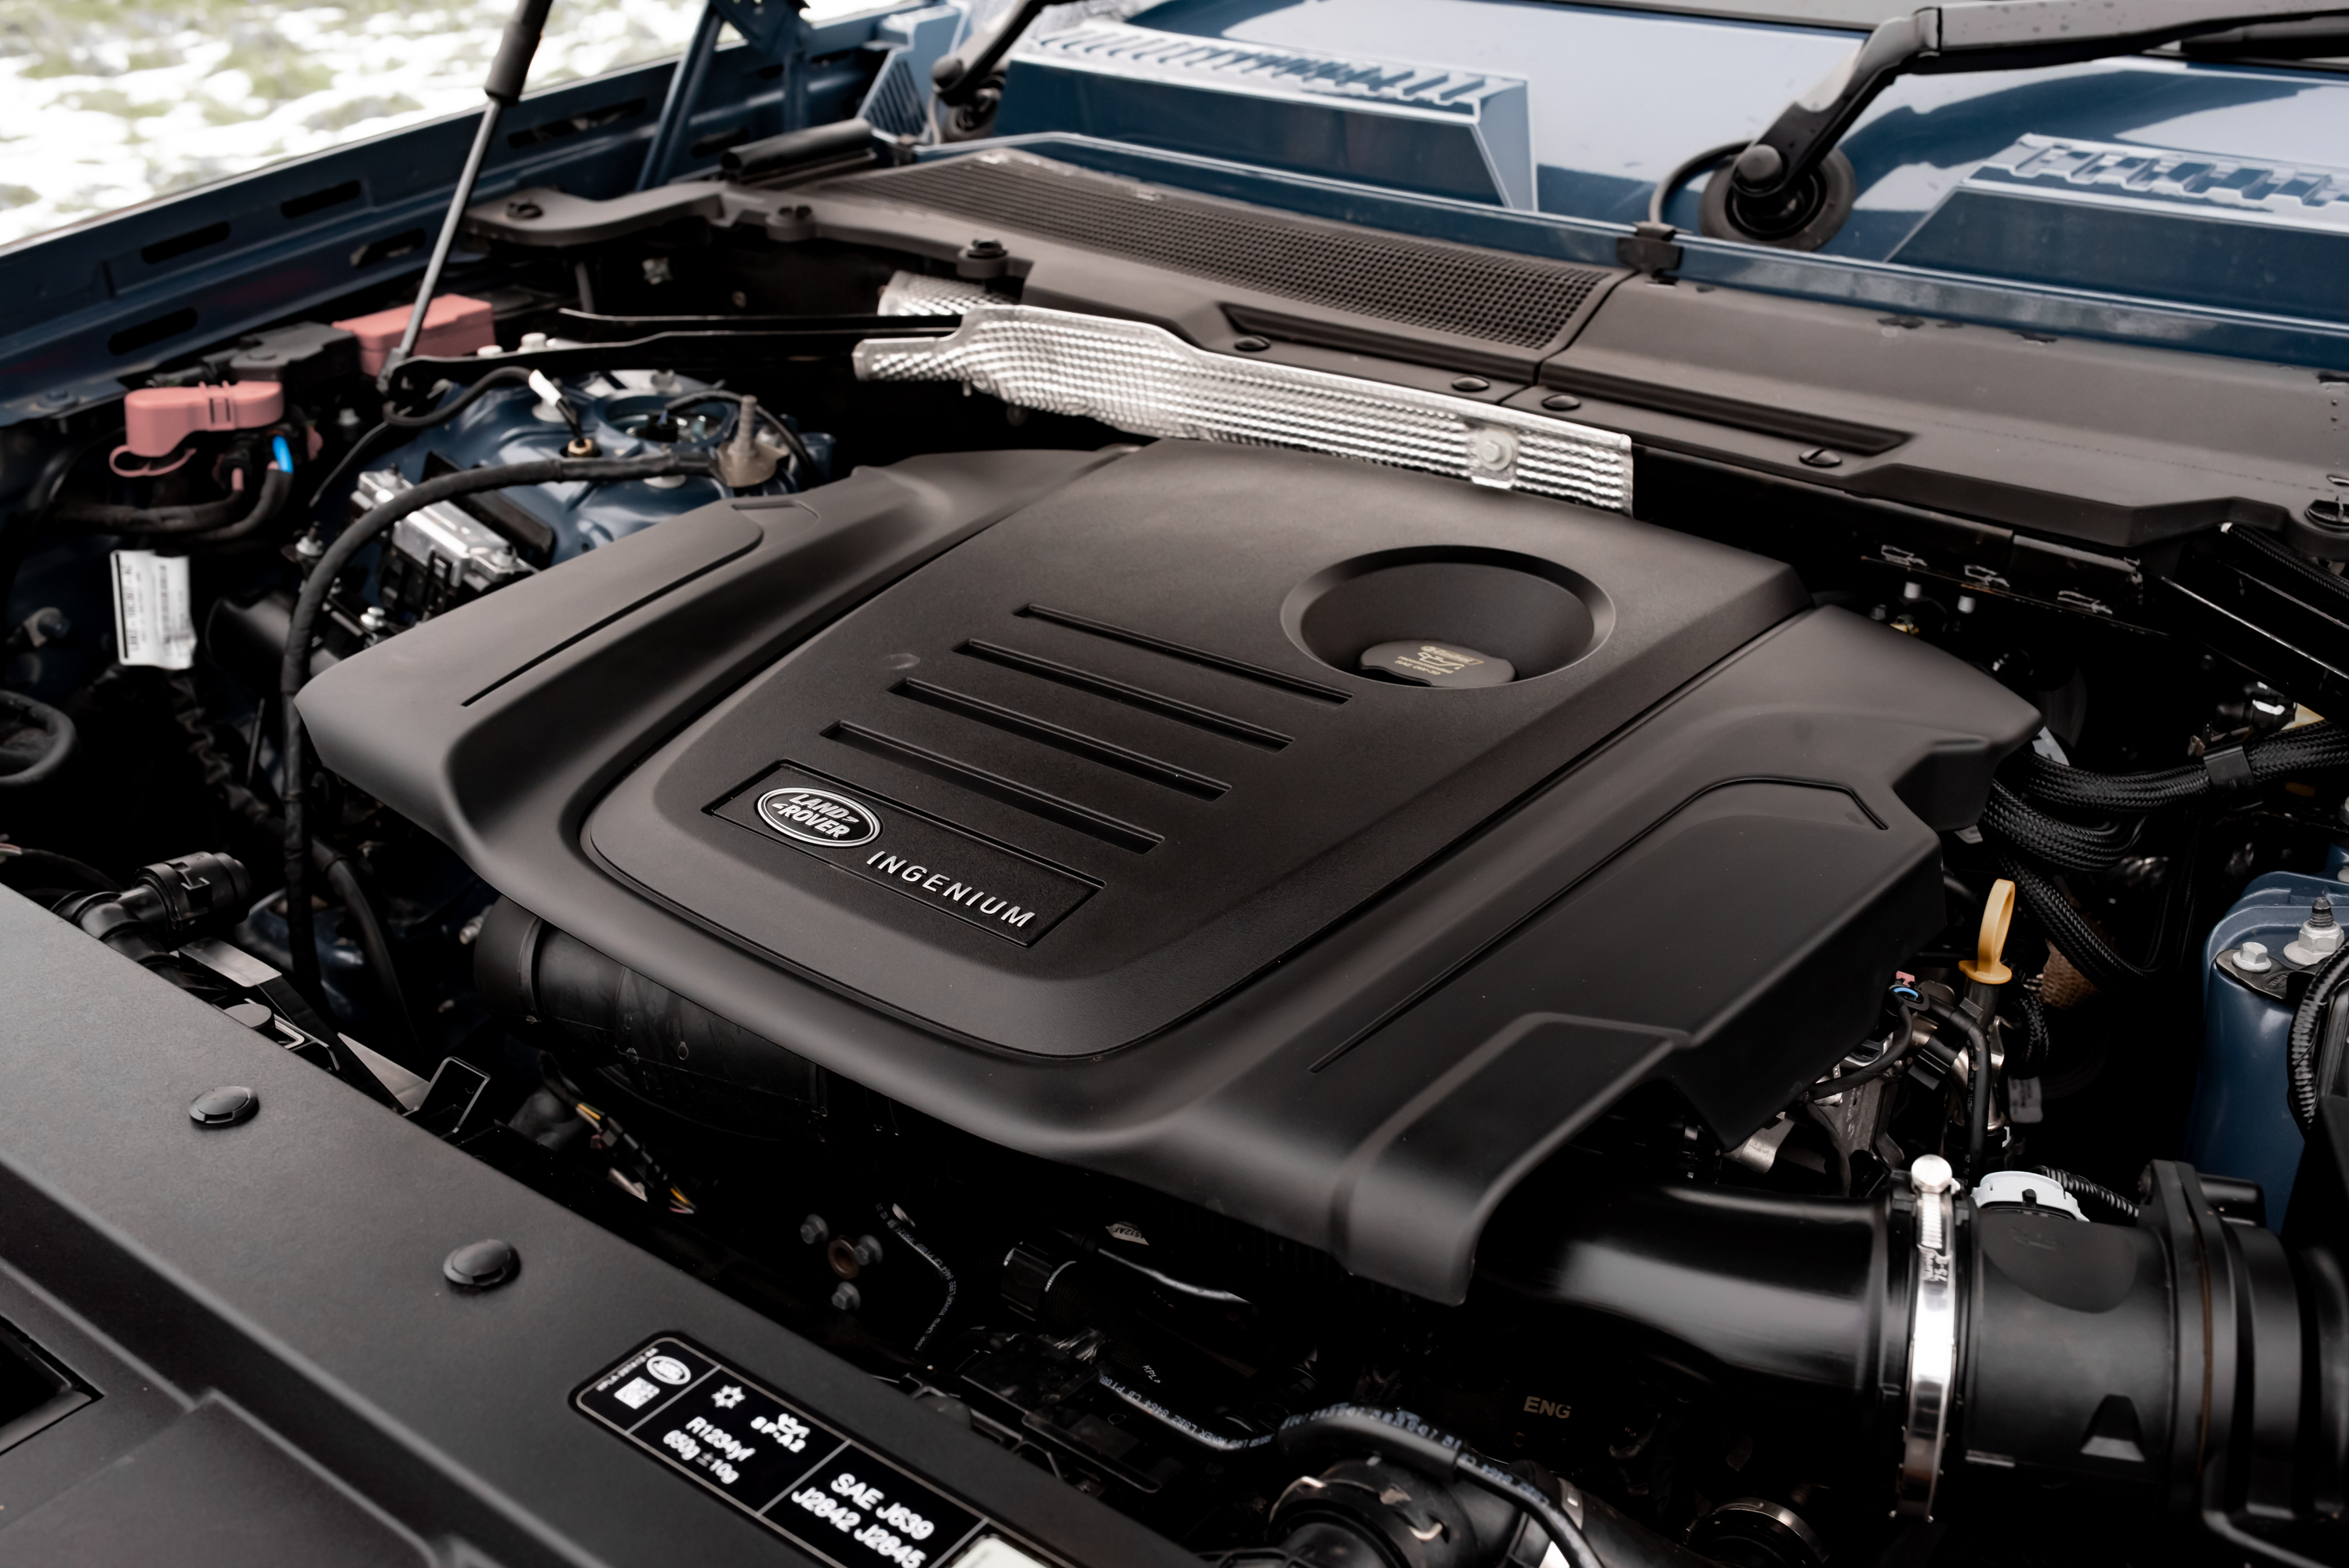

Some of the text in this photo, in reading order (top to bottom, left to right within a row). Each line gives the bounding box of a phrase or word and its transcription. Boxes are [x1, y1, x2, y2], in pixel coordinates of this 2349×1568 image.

[772, 803, 851, 839] ROVER
[789, 793, 859, 823] LAND
[866, 851, 1036, 928] INGENIUM
[1523, 1396, 1571, 1419] ENG
[791, 1487, 928, 1568] J2842 J2845
[831, 1473, 935, 1541] SAE J639
